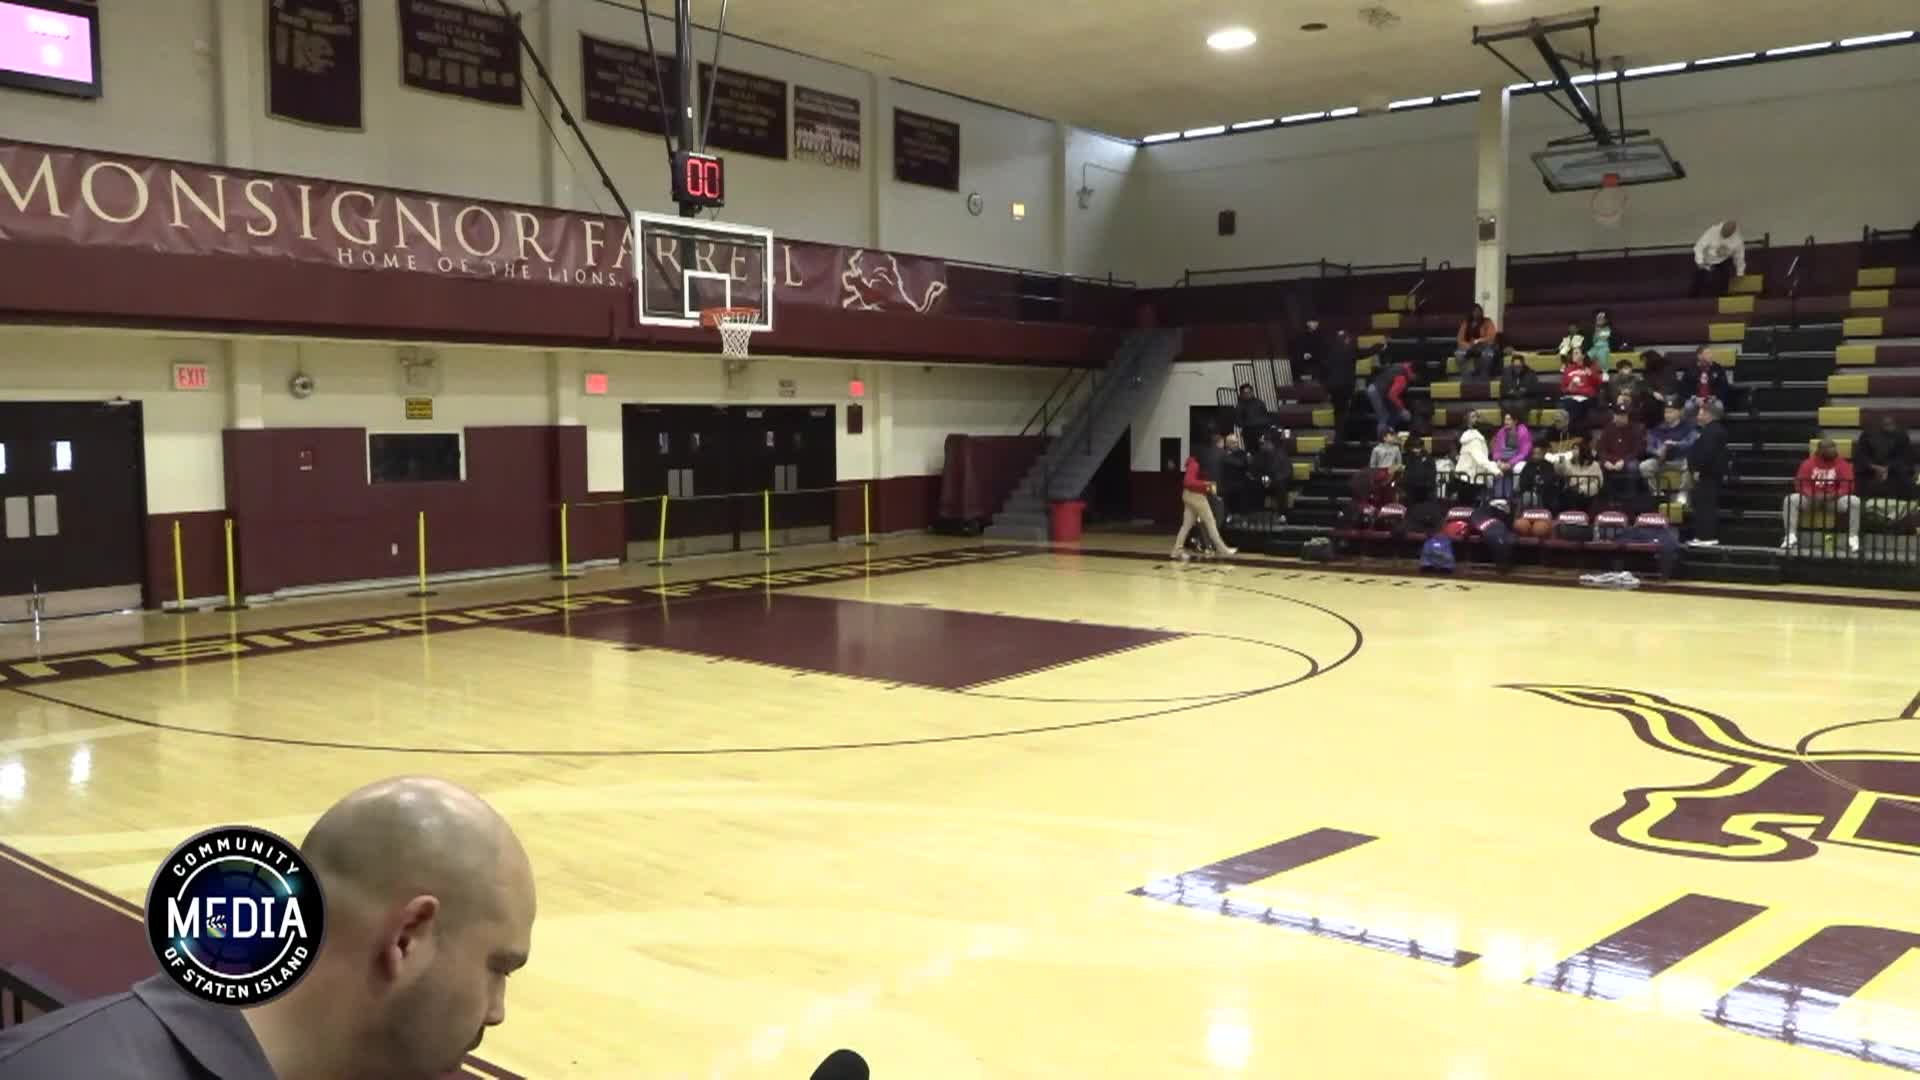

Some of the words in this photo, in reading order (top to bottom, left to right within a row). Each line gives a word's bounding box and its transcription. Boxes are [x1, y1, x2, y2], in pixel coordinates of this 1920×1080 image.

[687, 158, 719, 198] 00
[0, 153, 554, 261] MONSIGNOR
[582, 219, 803, 287] FARREL
[337, 247, 416, 270] HOME
[438, 257, 473, 273] OF
[489, 262, 530, 280] THE
[548, 267, 624, 287] LIONS.
[178, 366, 208, 386] EXIT
[0, 594, 632, 682] NSIGNOR
